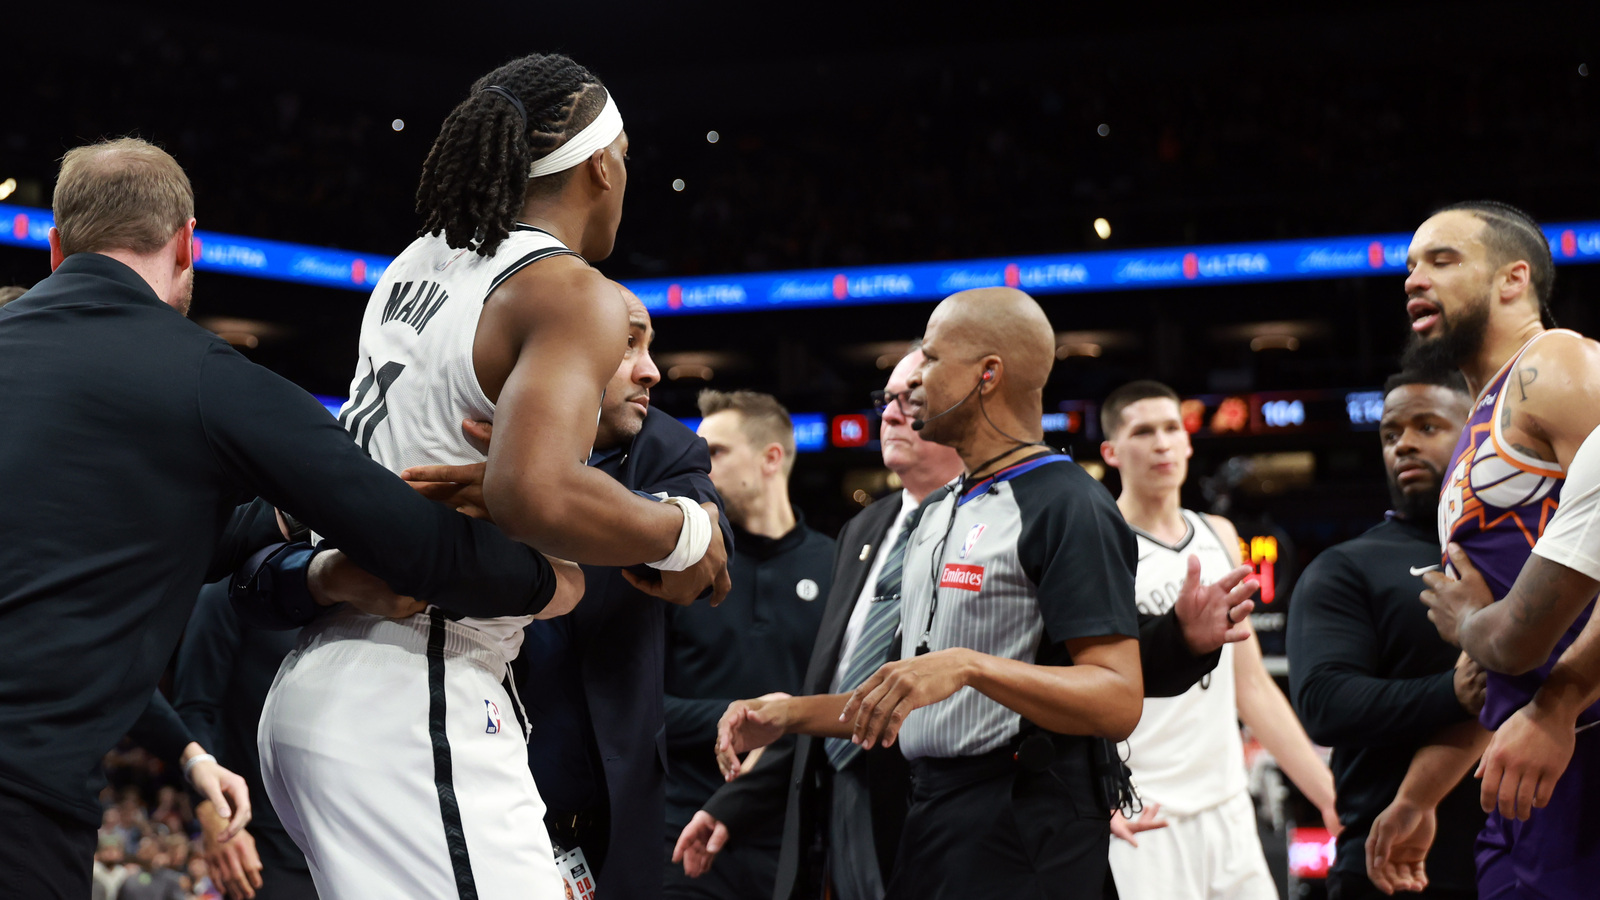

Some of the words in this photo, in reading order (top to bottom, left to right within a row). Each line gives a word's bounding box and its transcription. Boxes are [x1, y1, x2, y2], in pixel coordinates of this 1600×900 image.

[1019, 263, 1089, 288] ULTRA
[1198, 253, 1271, 277] ULTRA
[381, 280, 449, 336] MANN
[1518, 366, 1538, 402] P
[941, 567, 982, 586] Emirates
